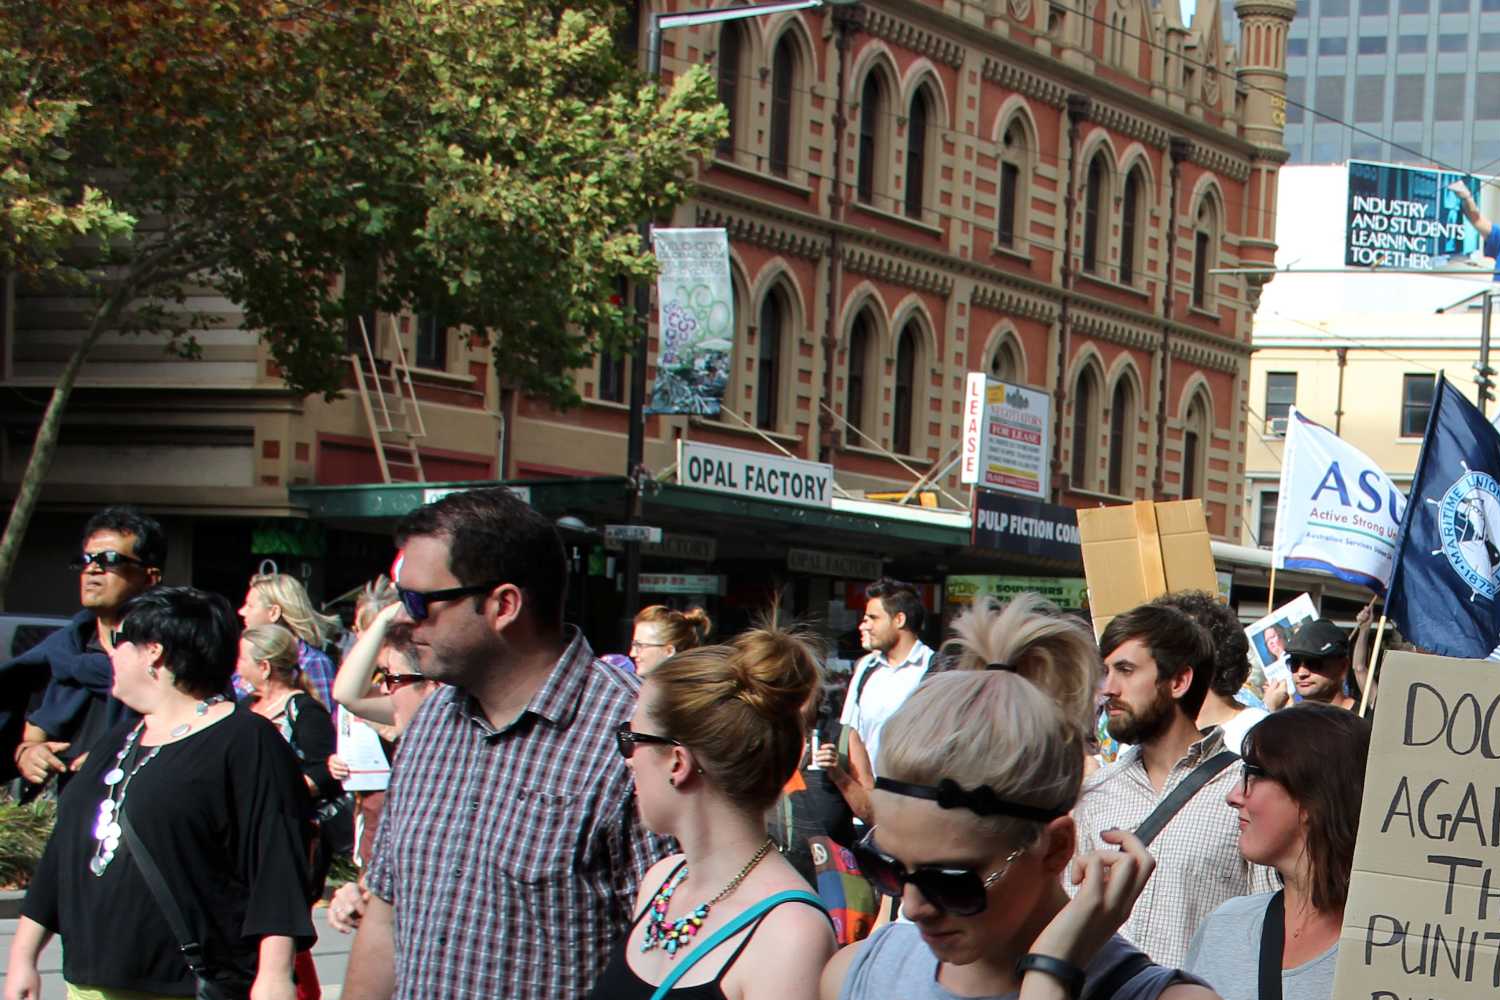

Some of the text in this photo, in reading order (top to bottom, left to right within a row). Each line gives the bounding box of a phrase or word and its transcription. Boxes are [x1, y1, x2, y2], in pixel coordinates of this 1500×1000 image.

[1353, 196, 1428, 218] INDUSTRY
[1352, 213, 1465, 240] AND STUDENTS
[1352, 230, 1426, 252] LEARNING
[966, 381, 978, 472] LEASE
[992, 424, 1038, 442] FOR LEASE
[689, 456, 827, 501] OPAL FACTORY
[977, 509, 1081, 545] PULP FICTION COM
[1310, 508, 1348, 524] Active
[1352, 514, 1385, 536] Strong
[1443, 489, 1464, 564] MARITIME
[1306, 531, 1343, 545] Australian
[1345, 535, 1373, 551] Services
[996, 584, 1063, 595] SOUVENIRS
